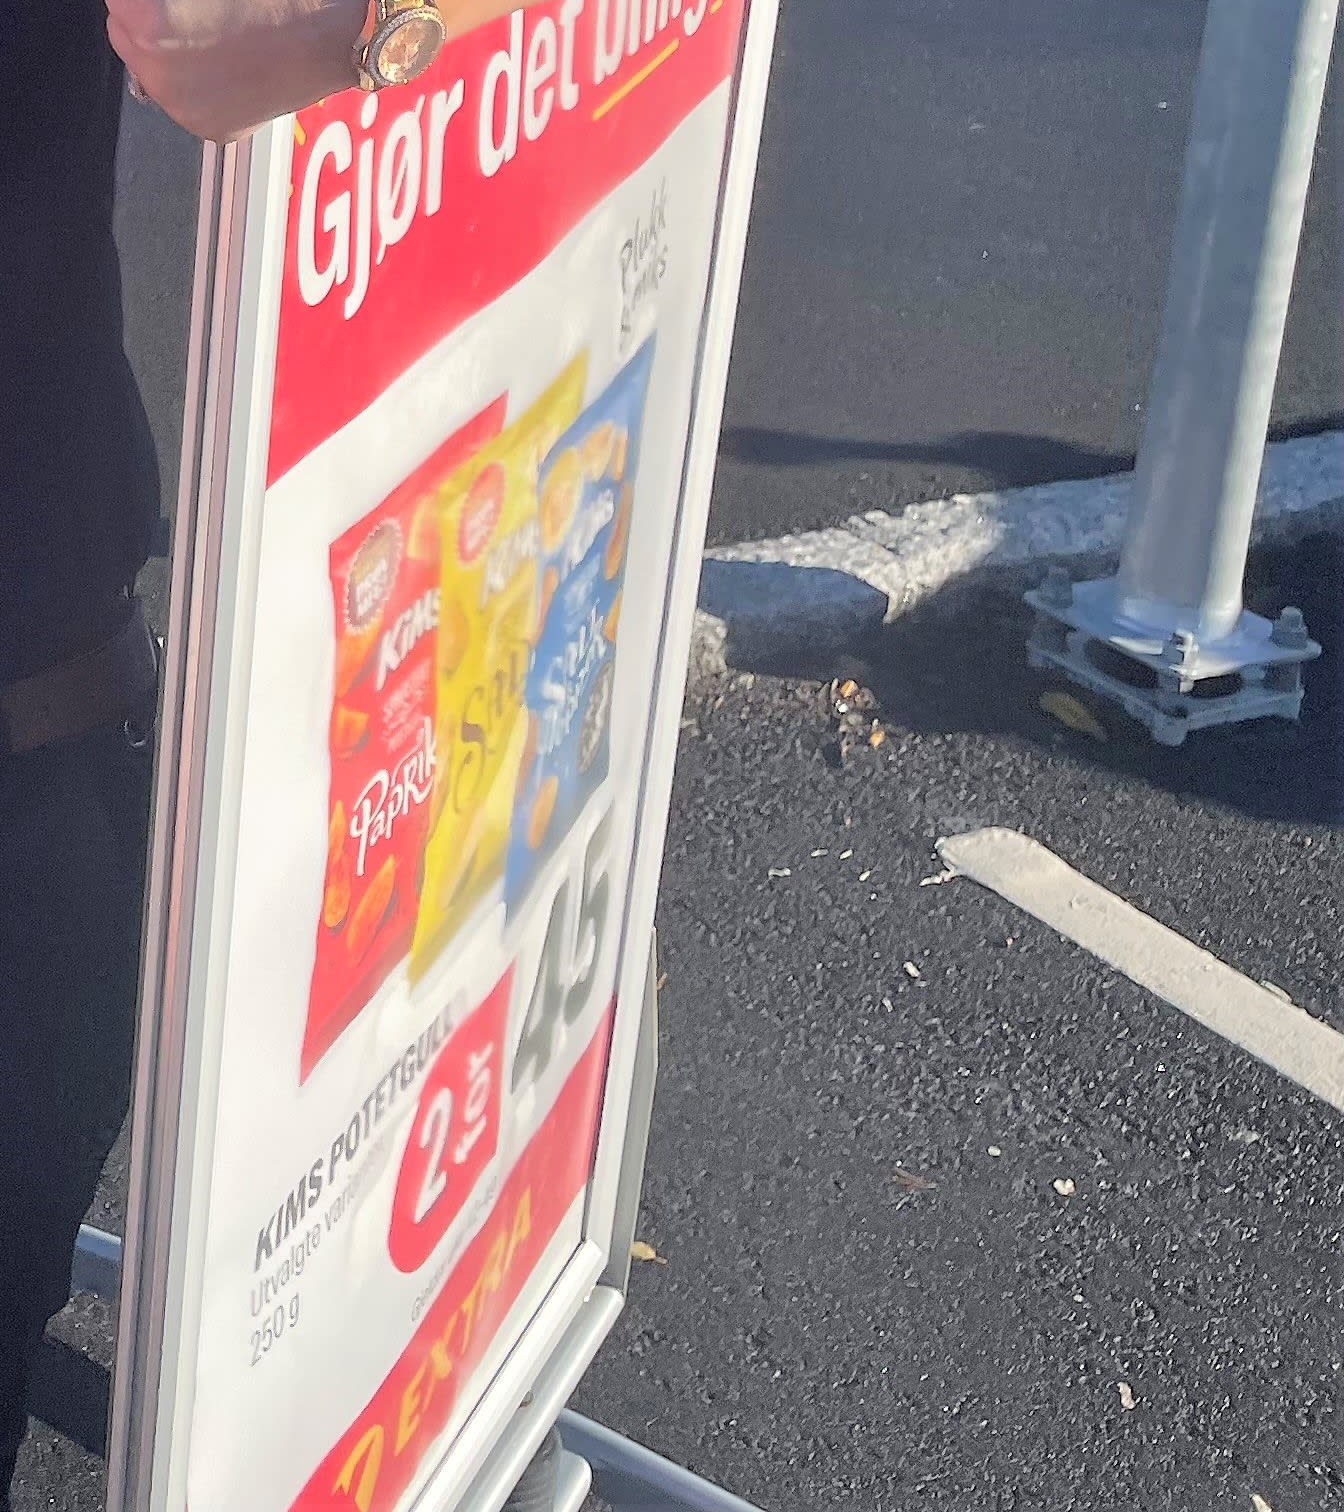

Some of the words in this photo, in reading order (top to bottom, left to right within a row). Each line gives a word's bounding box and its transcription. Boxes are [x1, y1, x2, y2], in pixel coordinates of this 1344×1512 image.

[296, 75, 464, 320] Gjør
[349, 715, 437, 877] Paprik
[254, 1157, 324, 1273] KIMS
[413, 1086, 452, 1224] 2
[250, 1223, 322, 1317] Utvalgte
[250, 1305, 286, 1368] 250
[288, 1292, 301, 1329] g
